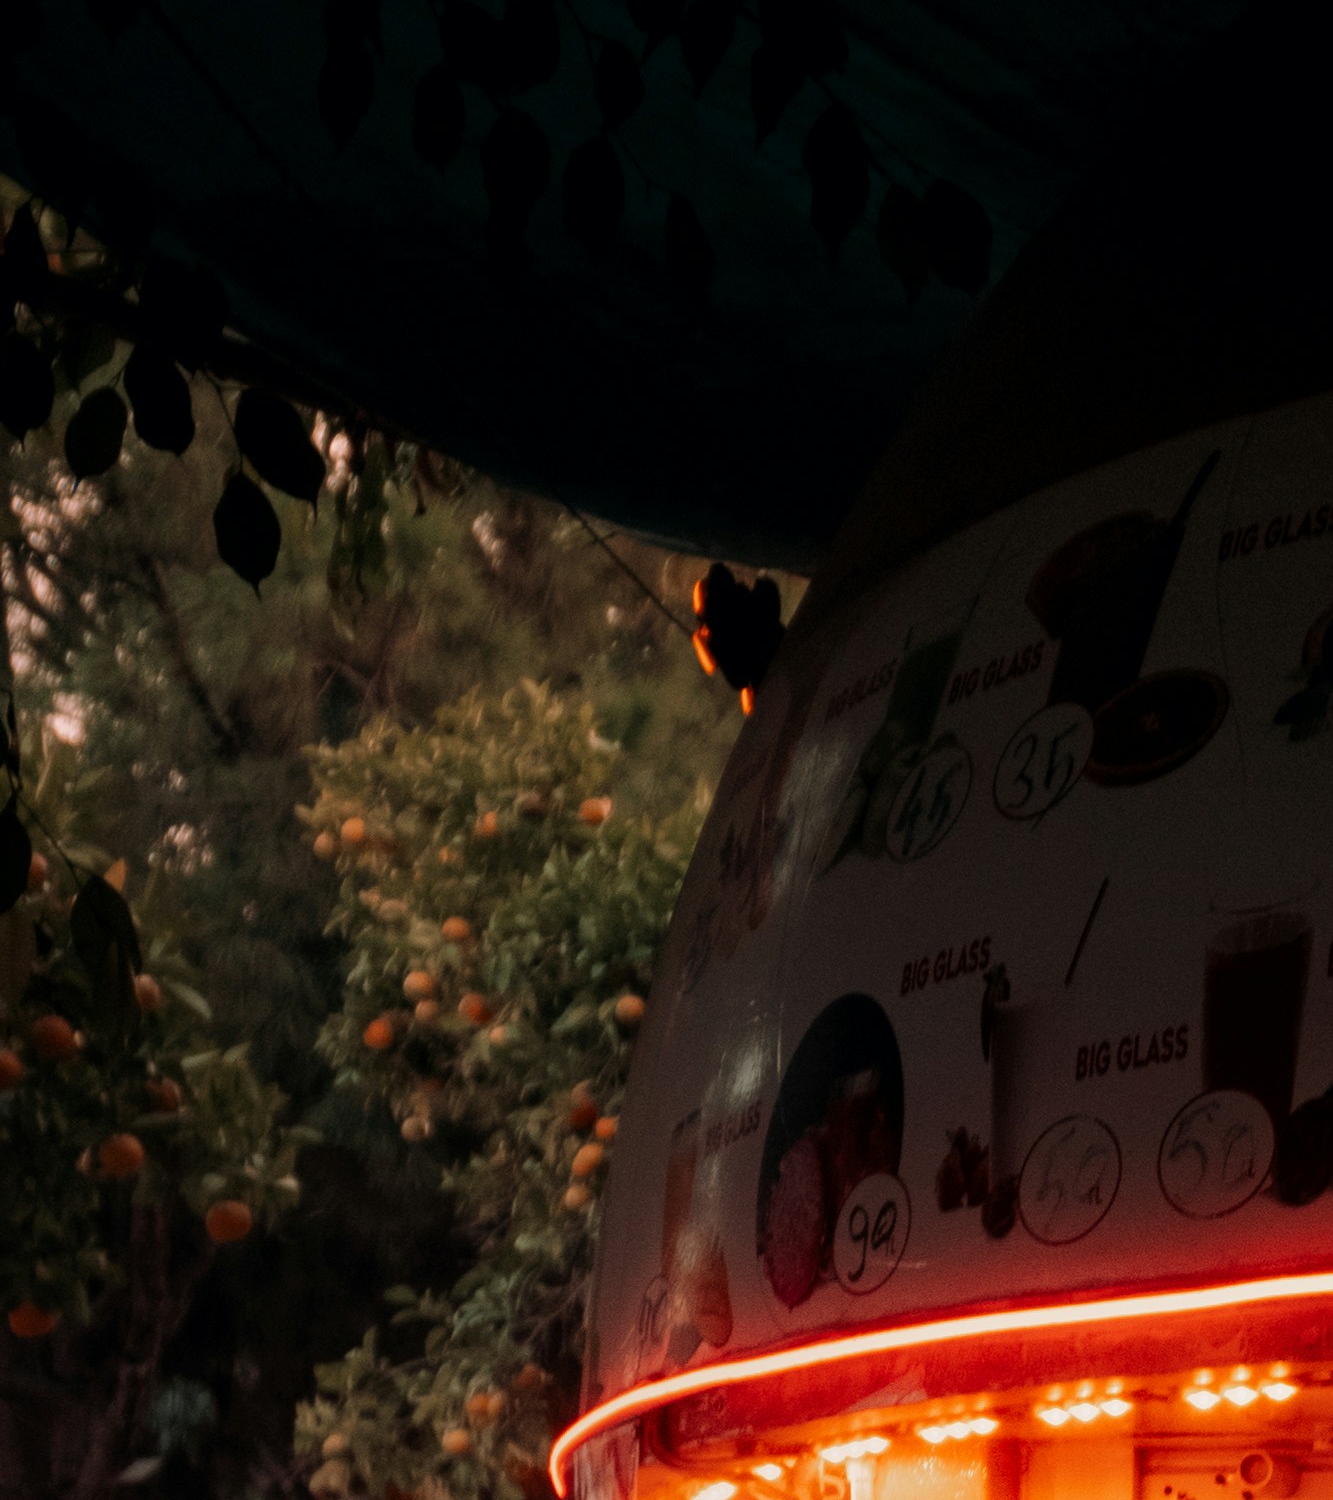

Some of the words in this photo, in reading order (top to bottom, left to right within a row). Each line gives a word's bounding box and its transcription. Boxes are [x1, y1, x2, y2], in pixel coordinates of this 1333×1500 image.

[1217, 518, 1258, 562] BIG
[947, 668, 978, 706] BIG
[982, 641, 1044, 691] GLASS
[900, 956, 930, 997] BIG
[932, 937, 992, 986] GLASS
[1075, 1044, 1113, 1082] BIG
[1116, 1025, 1190, 1072] GLASS
